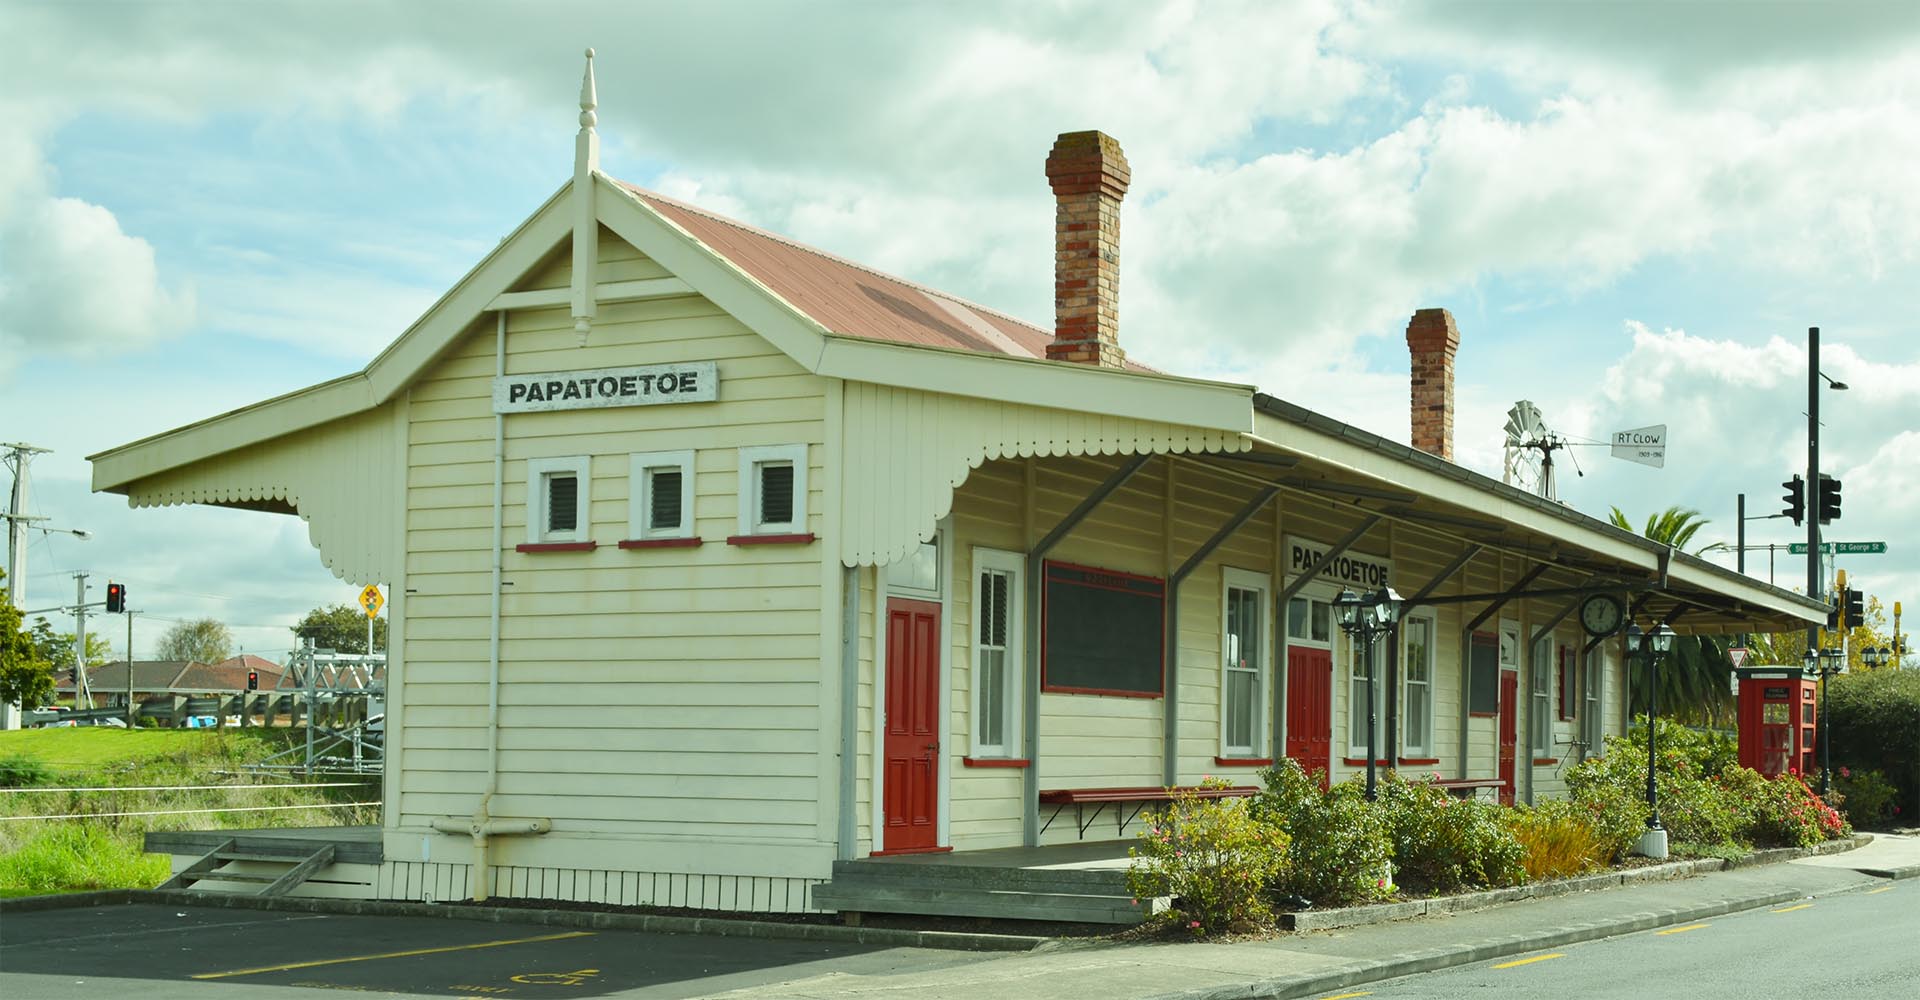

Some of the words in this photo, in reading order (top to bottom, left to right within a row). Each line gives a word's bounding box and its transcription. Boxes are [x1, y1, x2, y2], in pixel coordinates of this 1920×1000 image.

[509, 371, 698, 403] PAPATOETOE
[1633, 433, 1660, 444] CLOW
[1848, 544, 1870, 552] George
